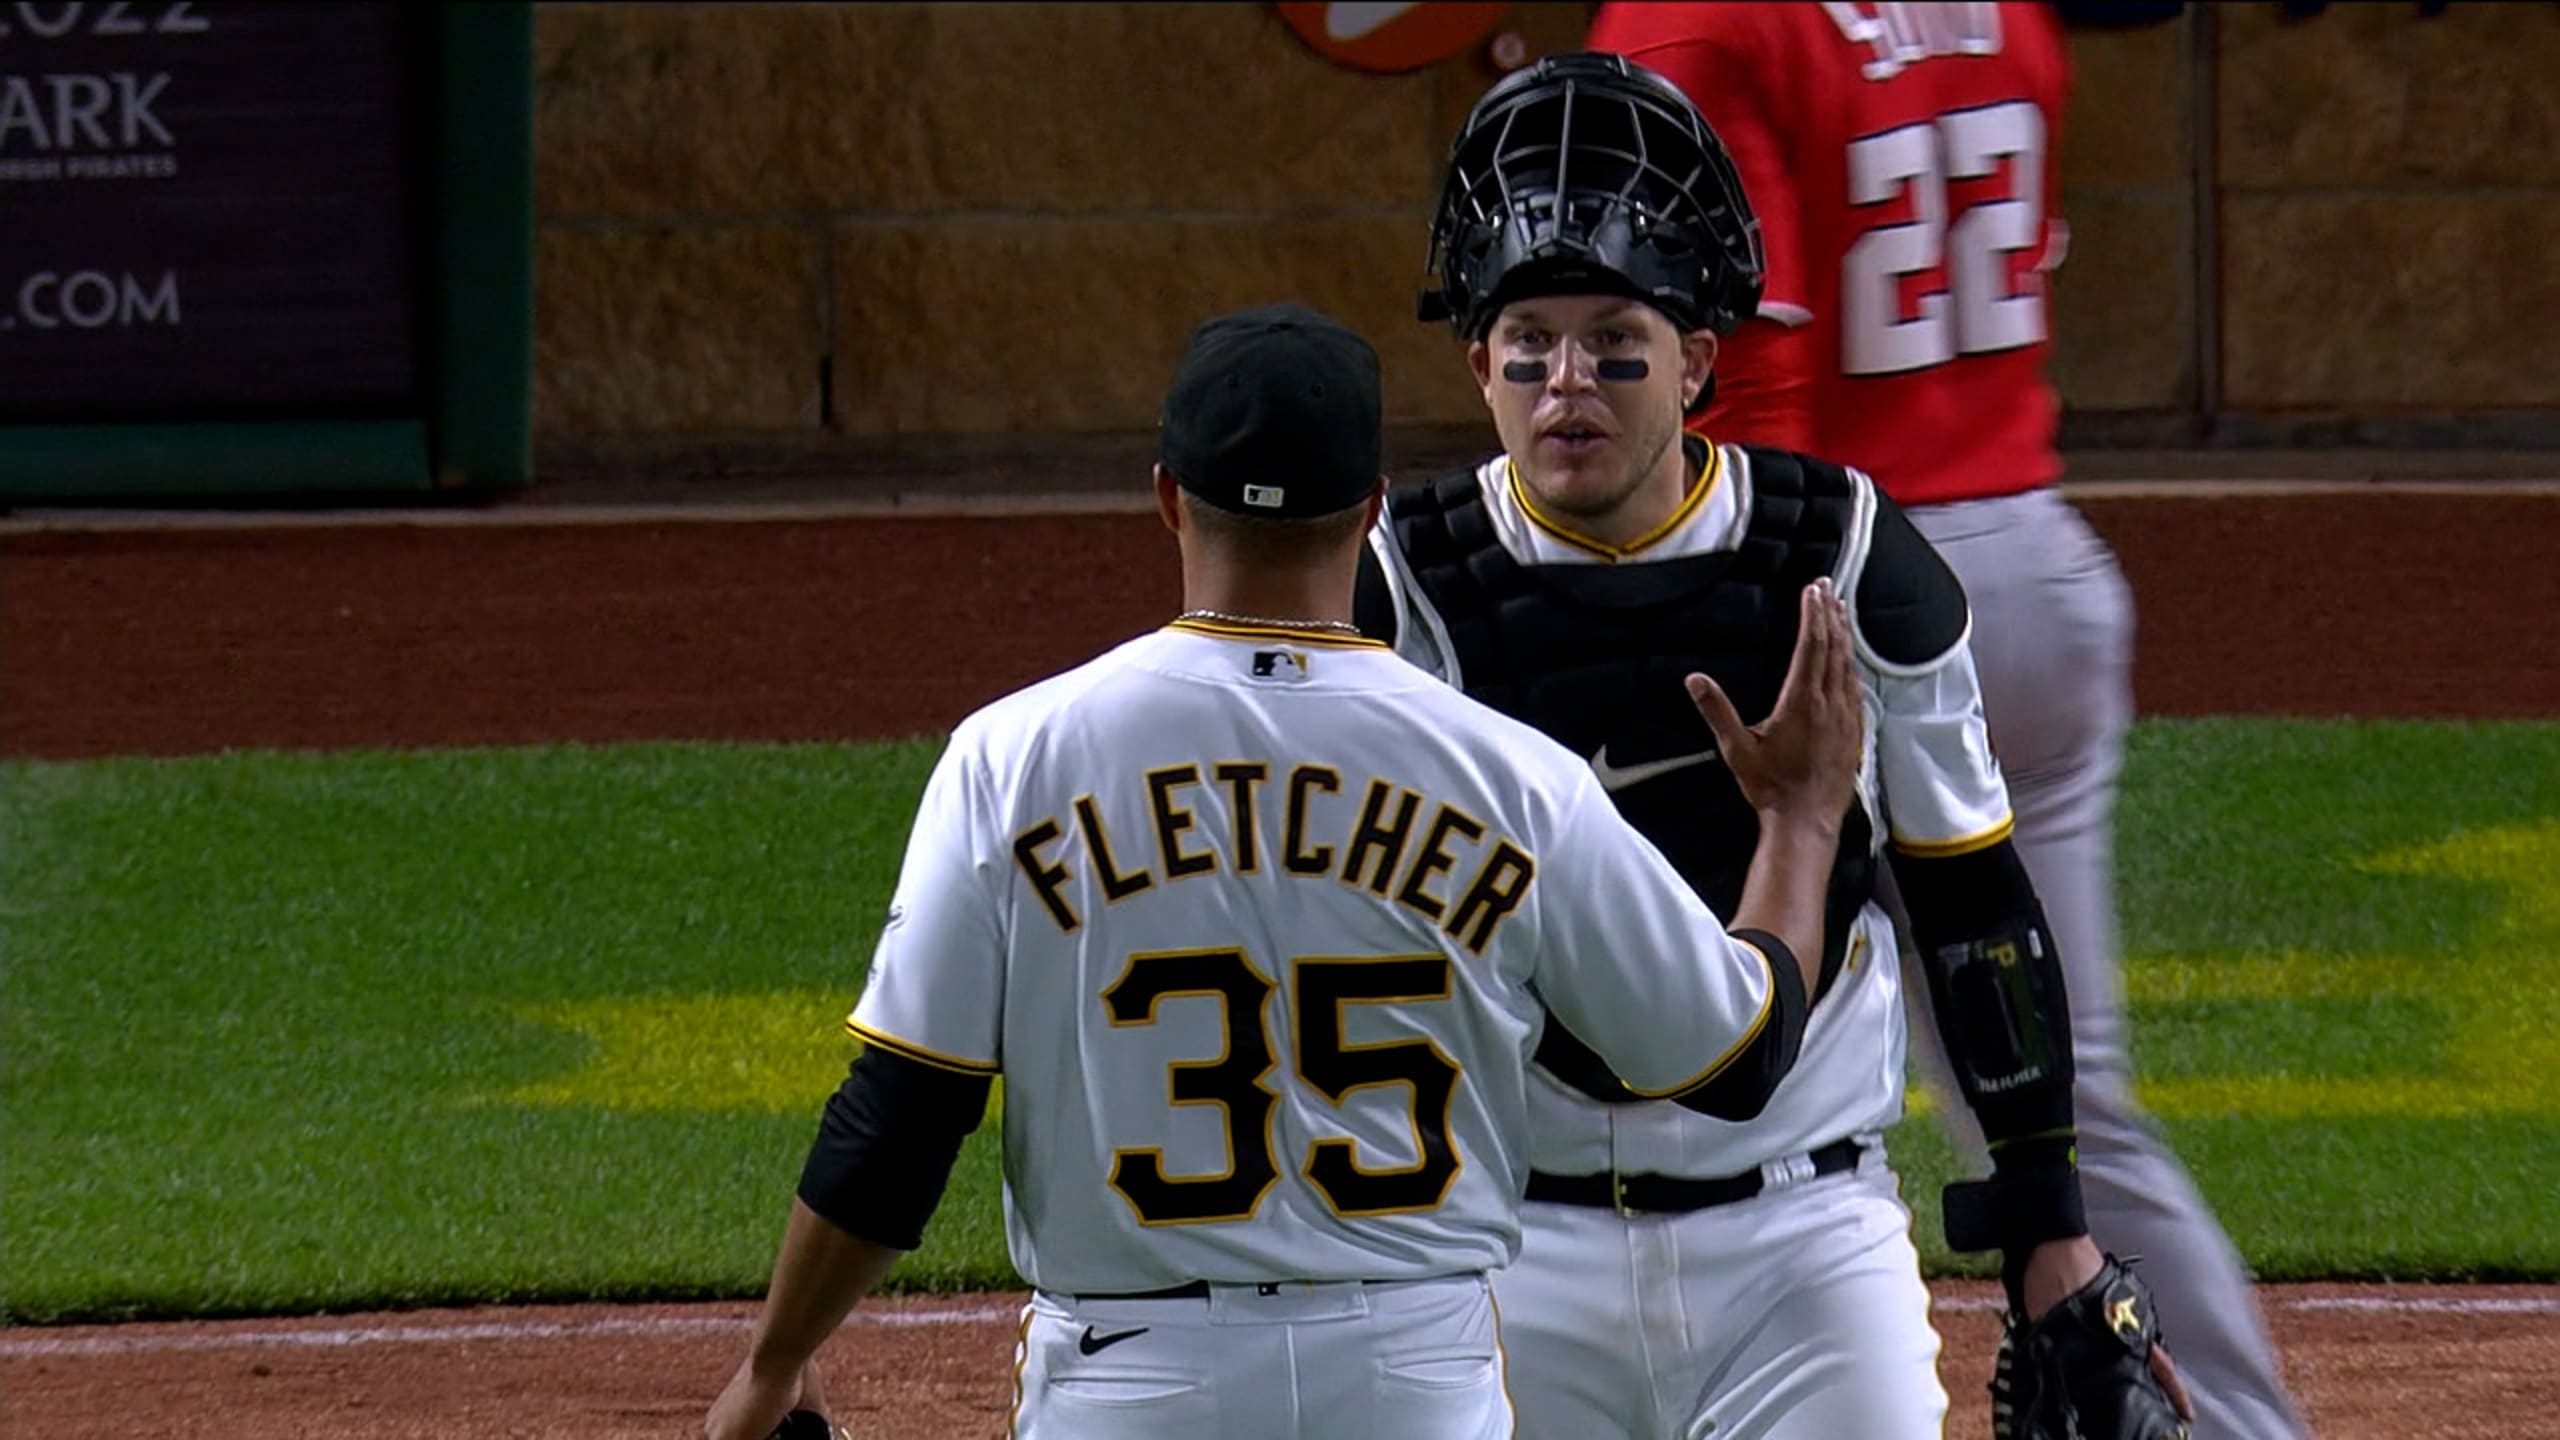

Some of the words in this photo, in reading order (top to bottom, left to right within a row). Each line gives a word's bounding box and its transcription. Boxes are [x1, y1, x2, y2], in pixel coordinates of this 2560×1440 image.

[1841, 99, 2048, 376] 22
[1013, 762, 1537, 956] FLETCHER
[1100, 946, 1462, 1226] 35
